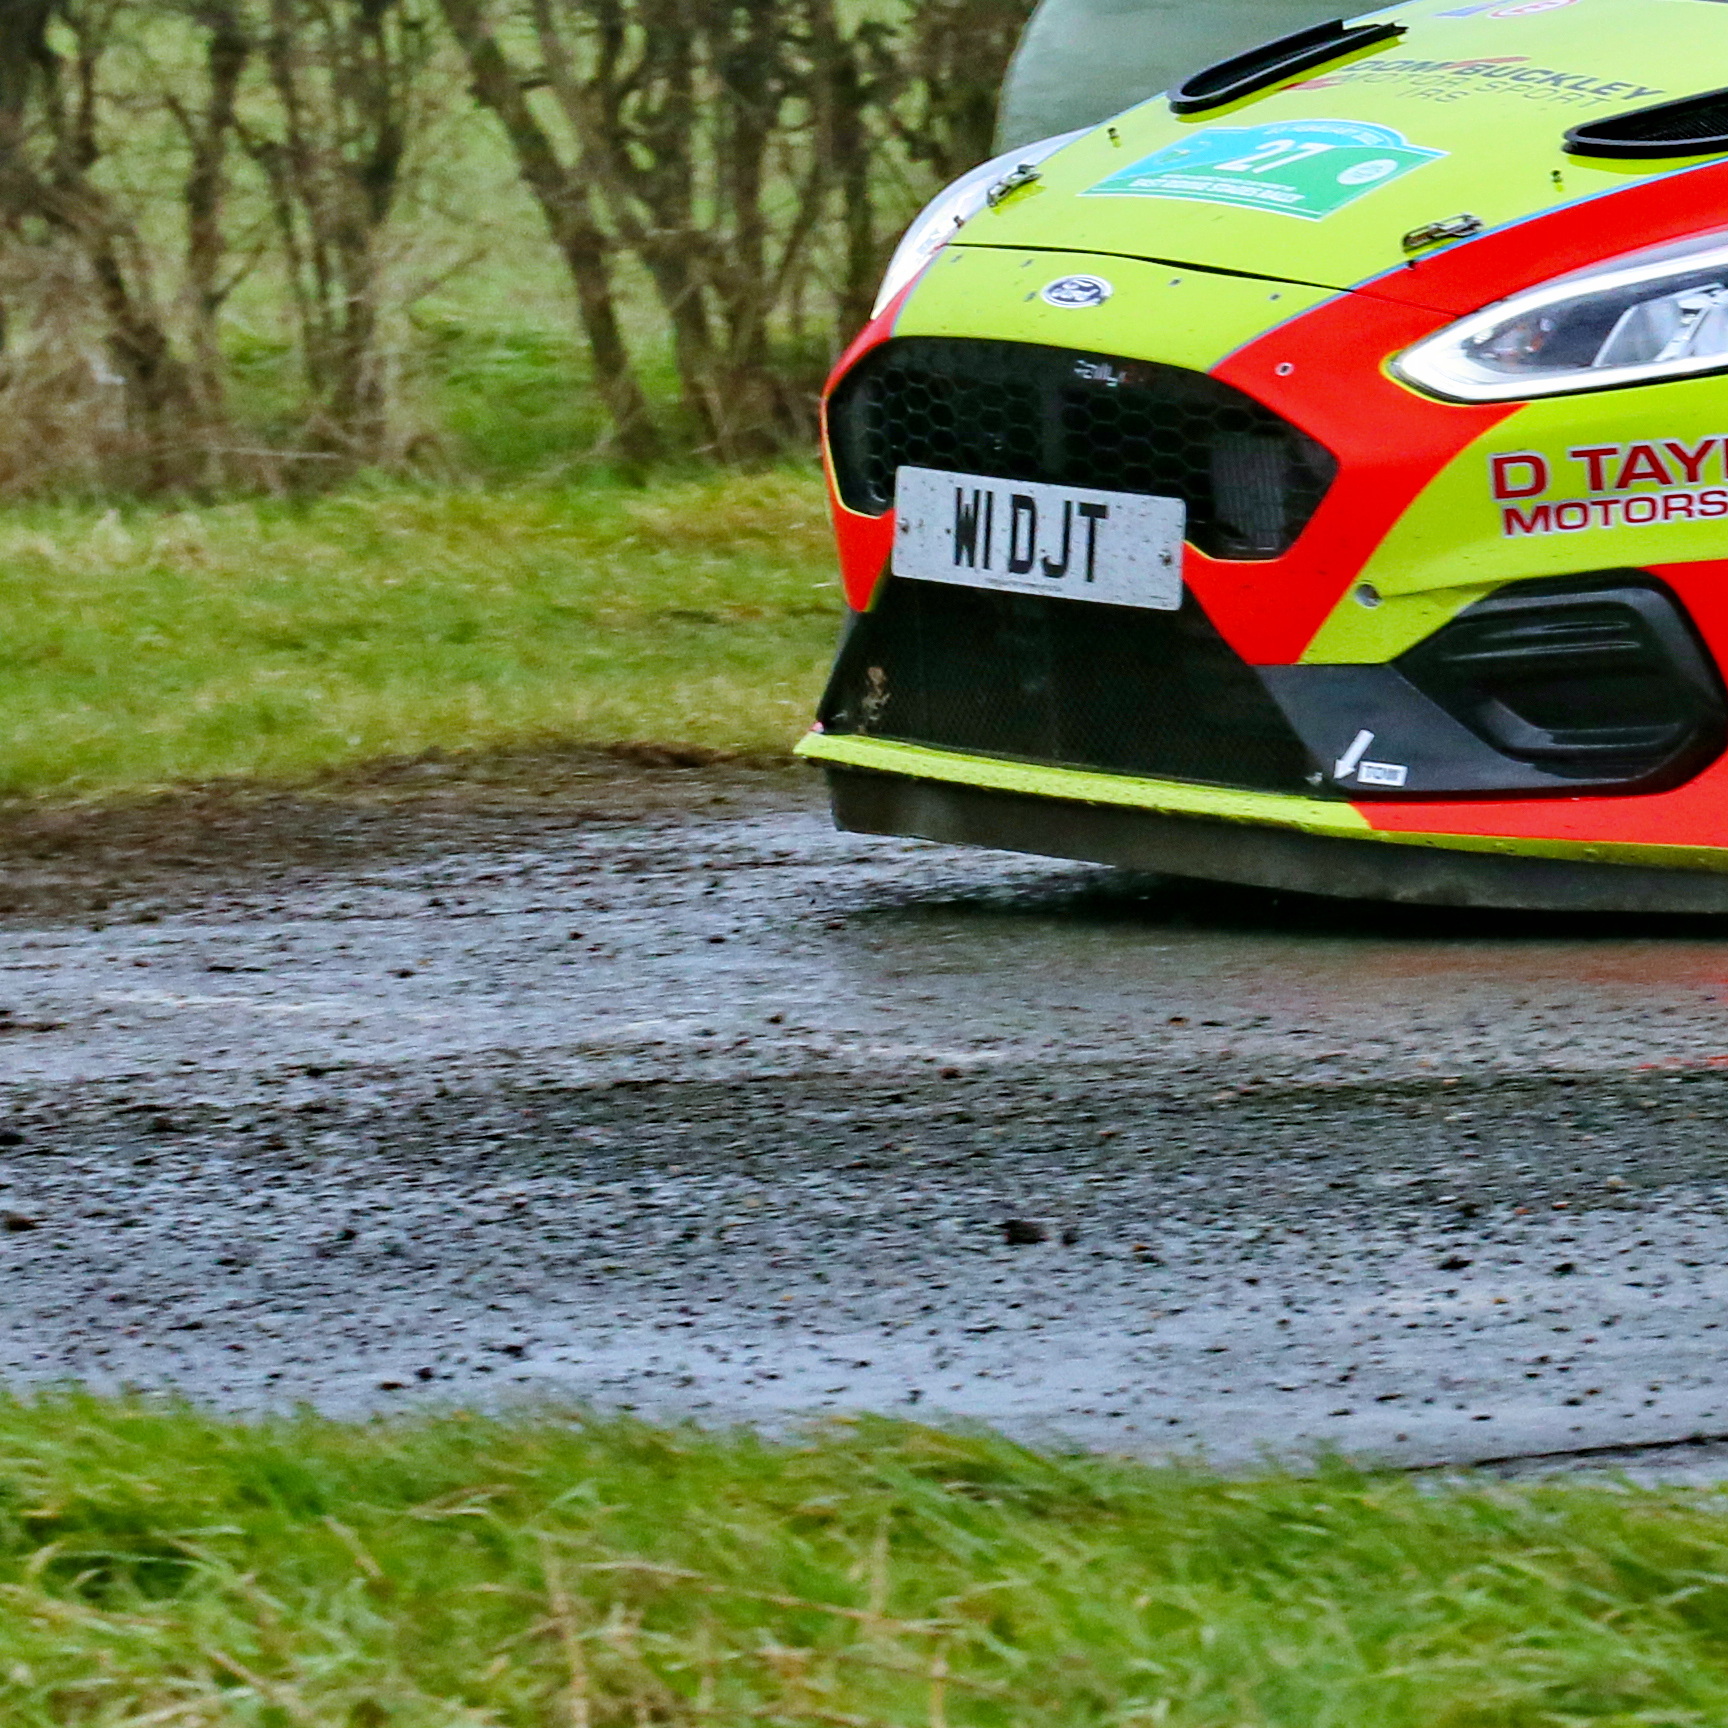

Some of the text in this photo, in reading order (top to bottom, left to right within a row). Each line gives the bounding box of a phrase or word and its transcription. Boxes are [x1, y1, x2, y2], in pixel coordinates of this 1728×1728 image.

[1451, 63, 1664, 100] BUCKLEY
[1473, 80, 1612, 108] SPORT
[1213, 139, 1337, 174] 27
[1491, 454, 1547, 500] D
[1009, 493, 1108, 583] DJT
